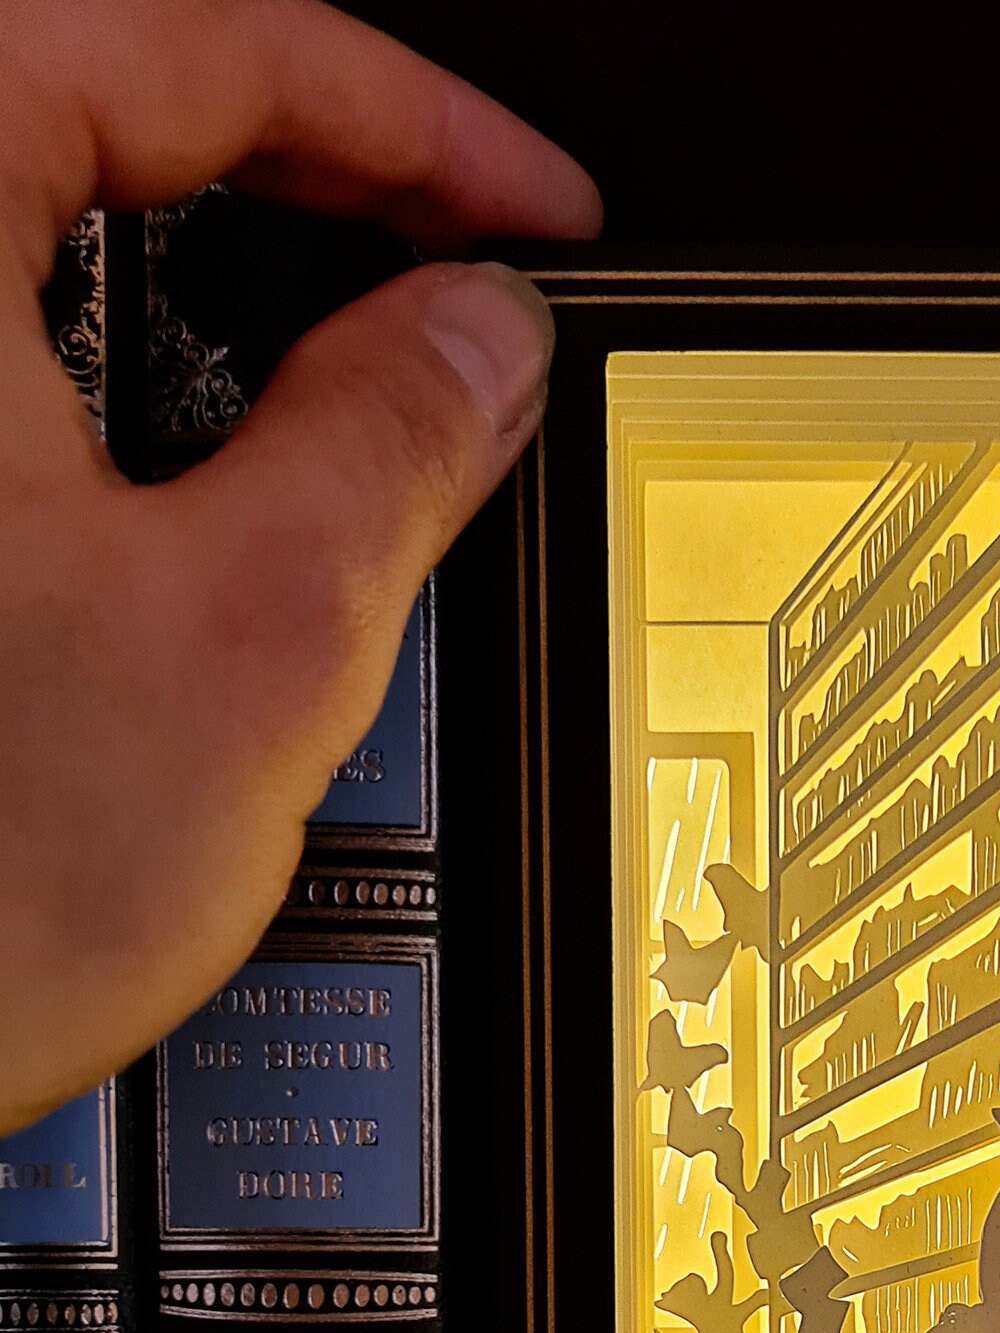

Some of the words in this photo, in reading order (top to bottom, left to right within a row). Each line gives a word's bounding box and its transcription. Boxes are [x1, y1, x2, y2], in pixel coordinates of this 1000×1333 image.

[204, 987, 393, 1016] OMTESSE
[193, 1040, 243, 1070] DE
[264, 1040, 394, 1071] SEGUR
[206, 1117, 379, 1146] GUSTAVE
[237, 1170, 344, 1200] DORE
